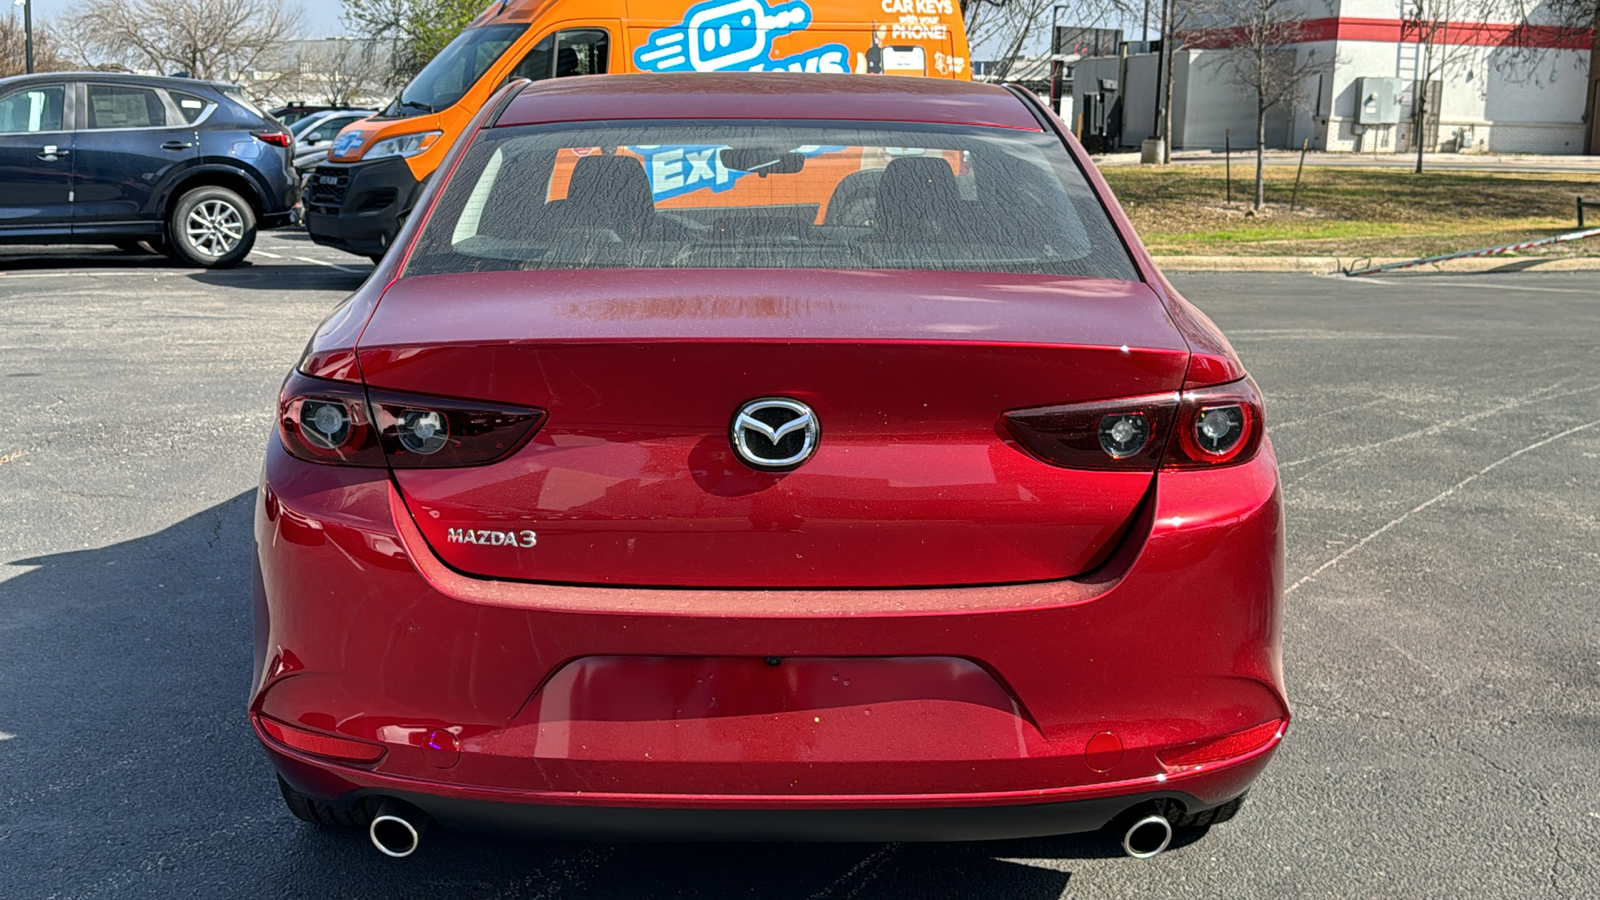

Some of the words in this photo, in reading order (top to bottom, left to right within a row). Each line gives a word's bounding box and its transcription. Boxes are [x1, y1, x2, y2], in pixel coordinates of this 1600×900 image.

[881, 0, 914, 13] CAR
[916, 0, 954, 14] KEYS
[892, 24, 947, 39] PHONE!
